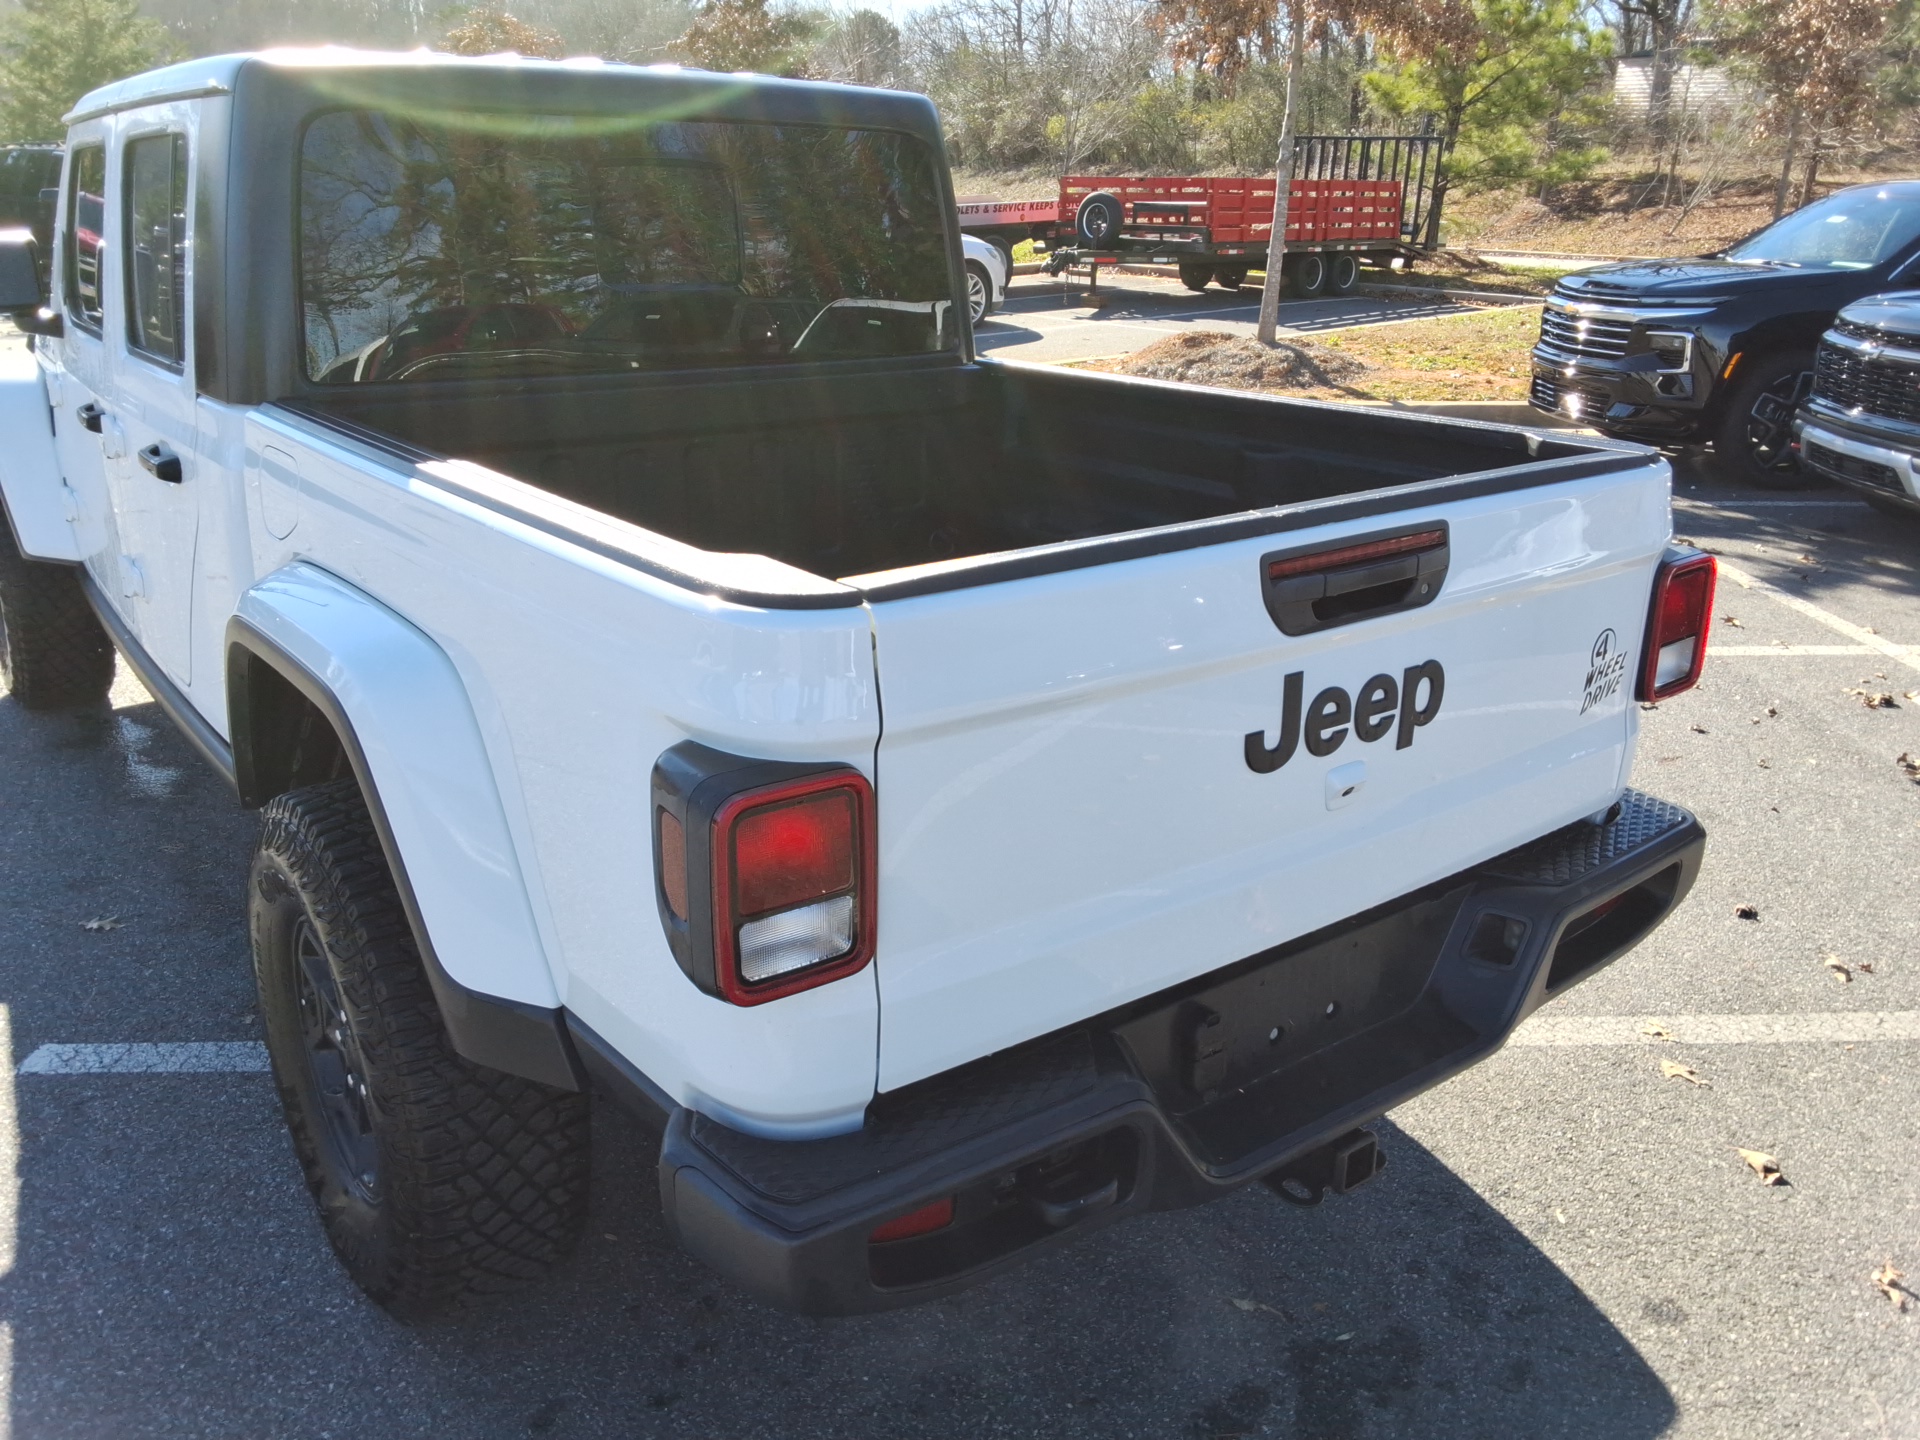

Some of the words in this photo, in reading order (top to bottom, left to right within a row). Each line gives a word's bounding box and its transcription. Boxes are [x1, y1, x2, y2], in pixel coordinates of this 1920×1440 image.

[982, 204, 990, 214] &
[992, 202, 1026, 214] SERVICE
[1028, 200, 1054, 212] KEEPS
[1595, 632, 1610, 661] 4
[1583, 650, 1628, 693] WHEEL
[1579, 673, 1623, 716] DRIVE
[1244, 658, 1446, 775] Jeep
